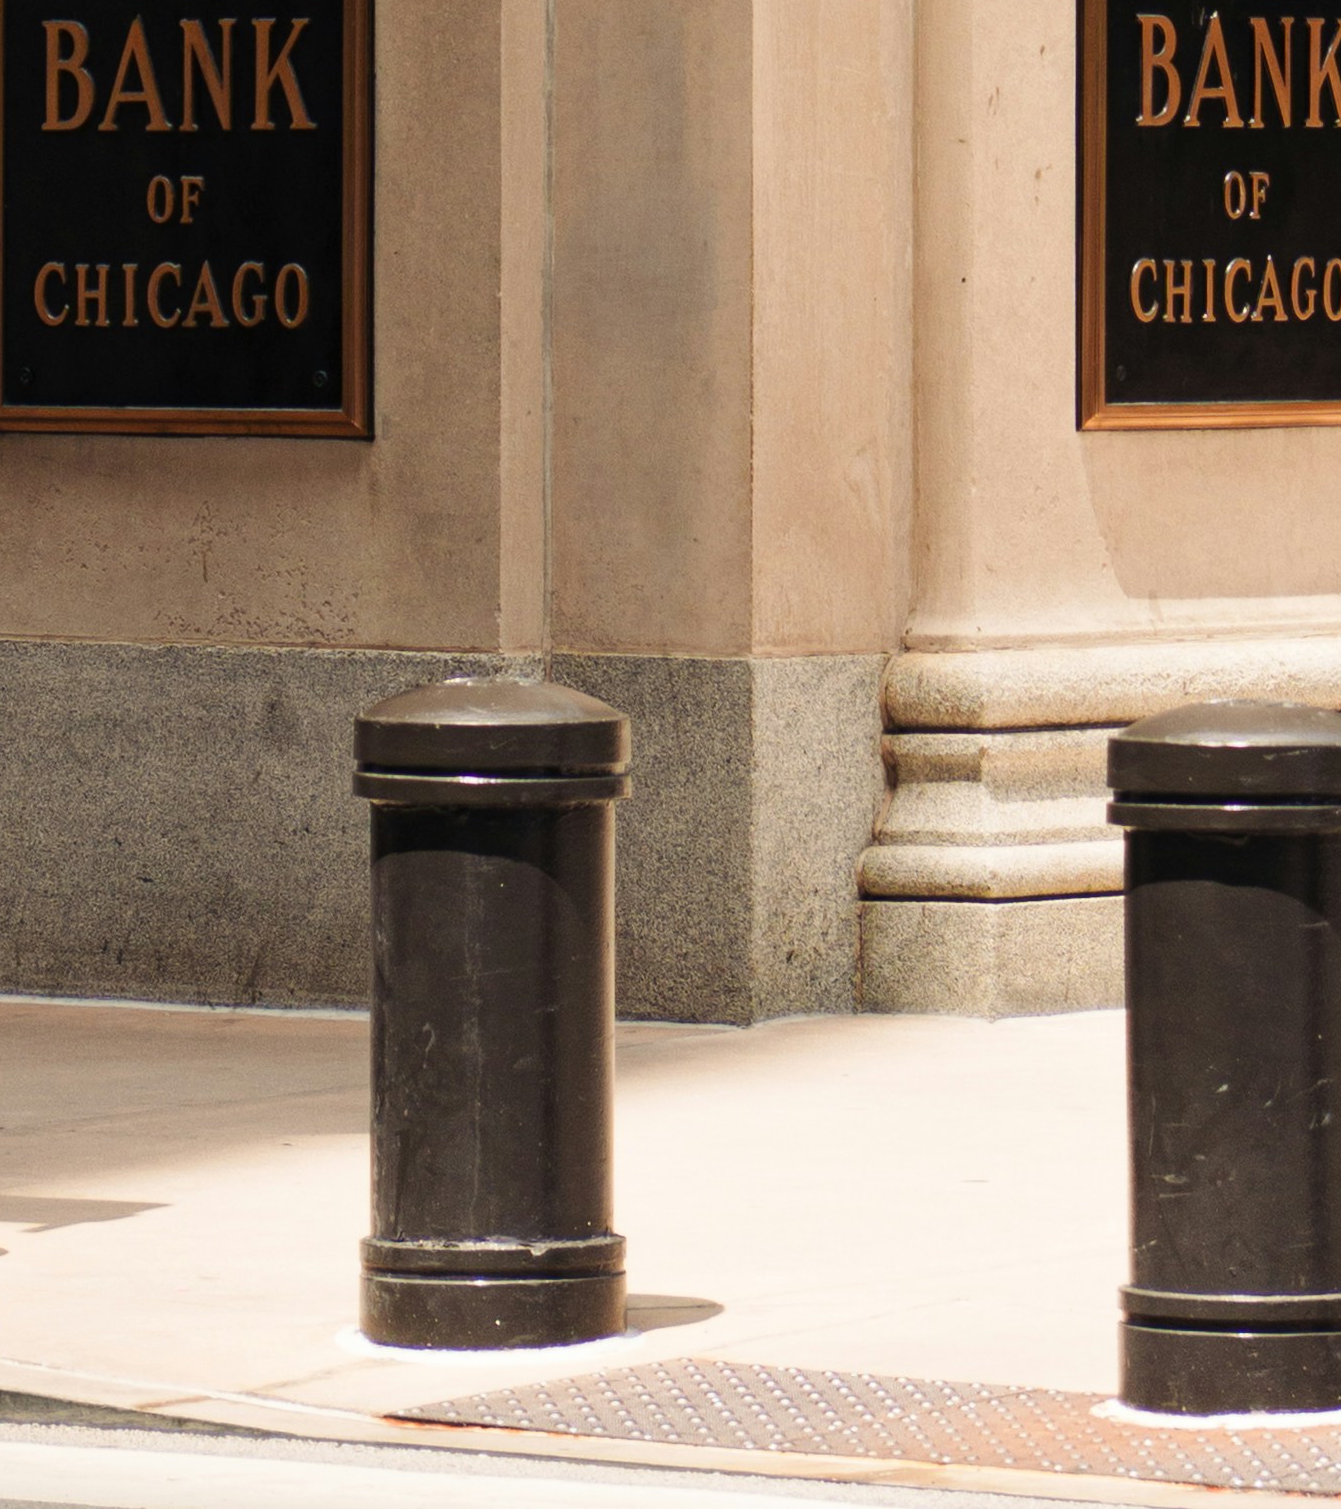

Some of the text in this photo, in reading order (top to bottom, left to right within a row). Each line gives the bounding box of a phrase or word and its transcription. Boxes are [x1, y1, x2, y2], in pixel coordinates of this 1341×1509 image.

[41, 17, 317, 132] BANK
[146, 174, 205, 224] OF
[1223, 170, 1271, 221] OF
[34, 260, 310, 328] CHICAGO
